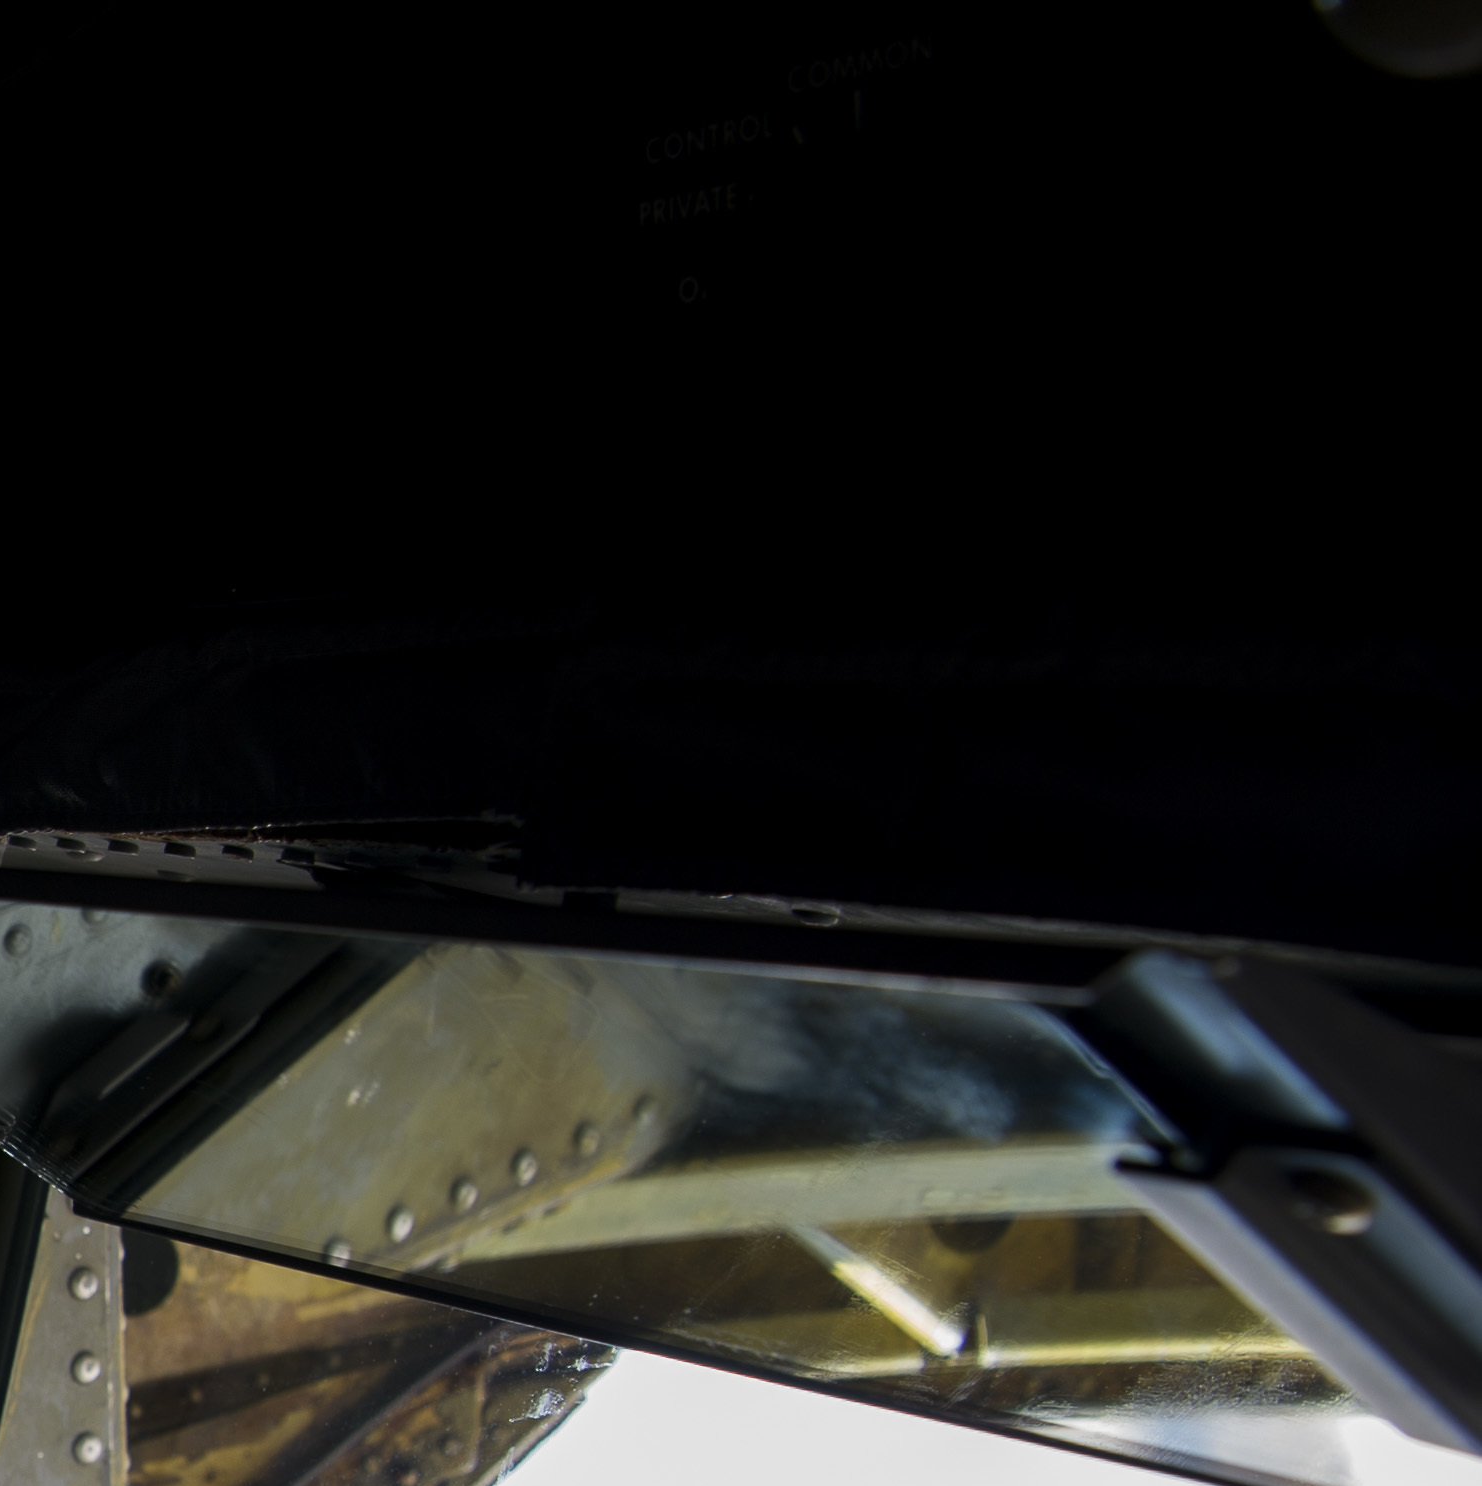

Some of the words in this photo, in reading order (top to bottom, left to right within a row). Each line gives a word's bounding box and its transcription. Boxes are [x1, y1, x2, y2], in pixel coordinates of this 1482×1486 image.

[787, 34, 933, 95] COMMON
[645, 112, 773, 165] CONTROL
[638, 182, 739, 228] PRIVATE
